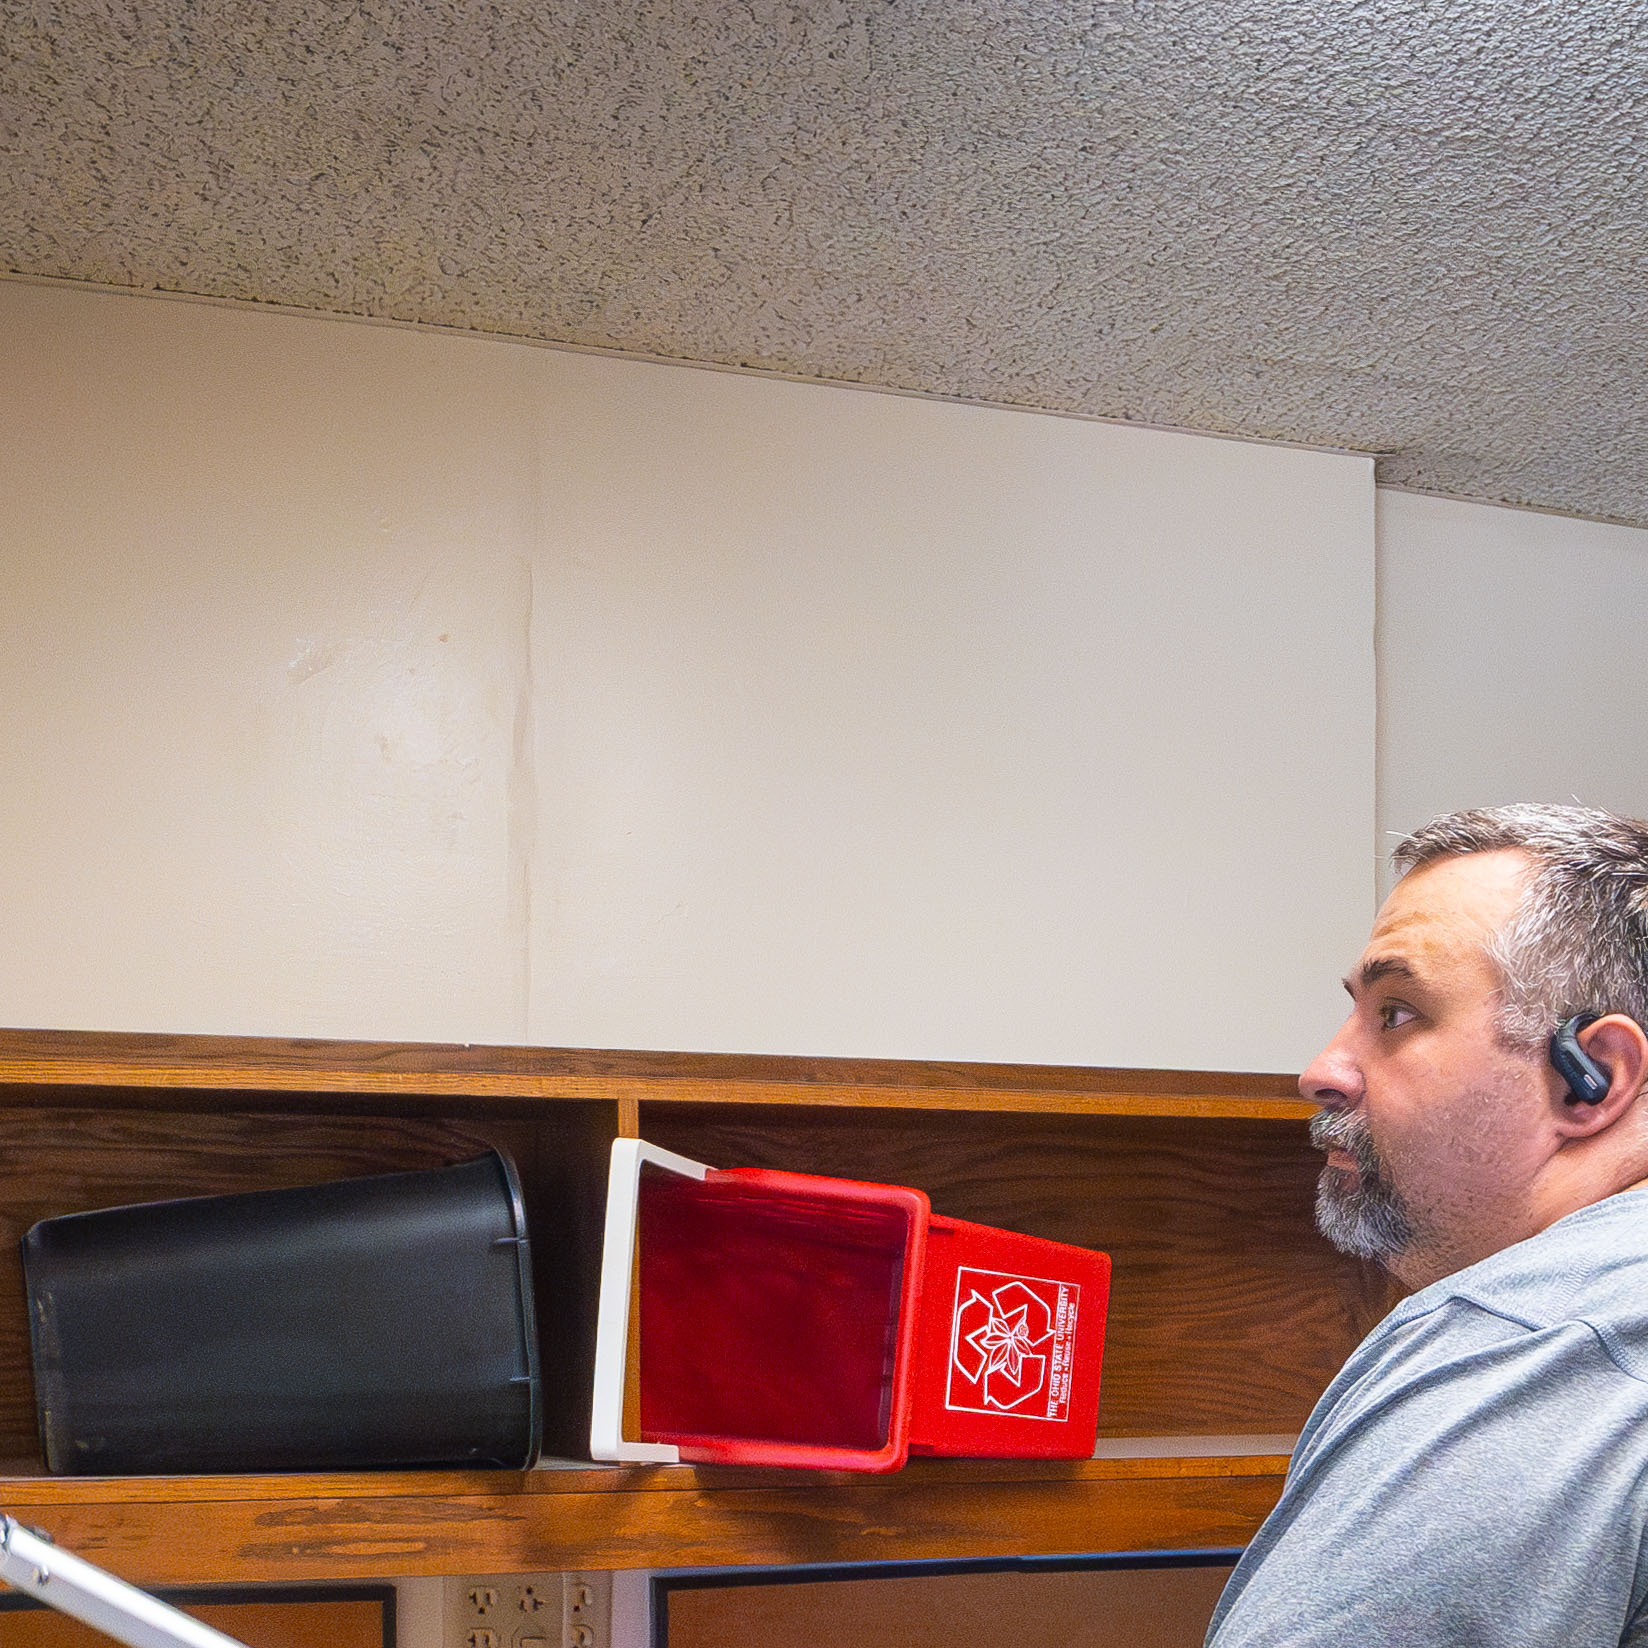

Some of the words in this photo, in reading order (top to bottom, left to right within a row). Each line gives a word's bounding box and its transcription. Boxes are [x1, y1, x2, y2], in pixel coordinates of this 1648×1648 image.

[1056, 1285, 1069, 1341] UNIVERSITY
[1053, 1344, 1064, 1371] STATE
[1051, 1373, 1062, 1397] OHIO
[1049, 1400, 1059, 1416] THE
